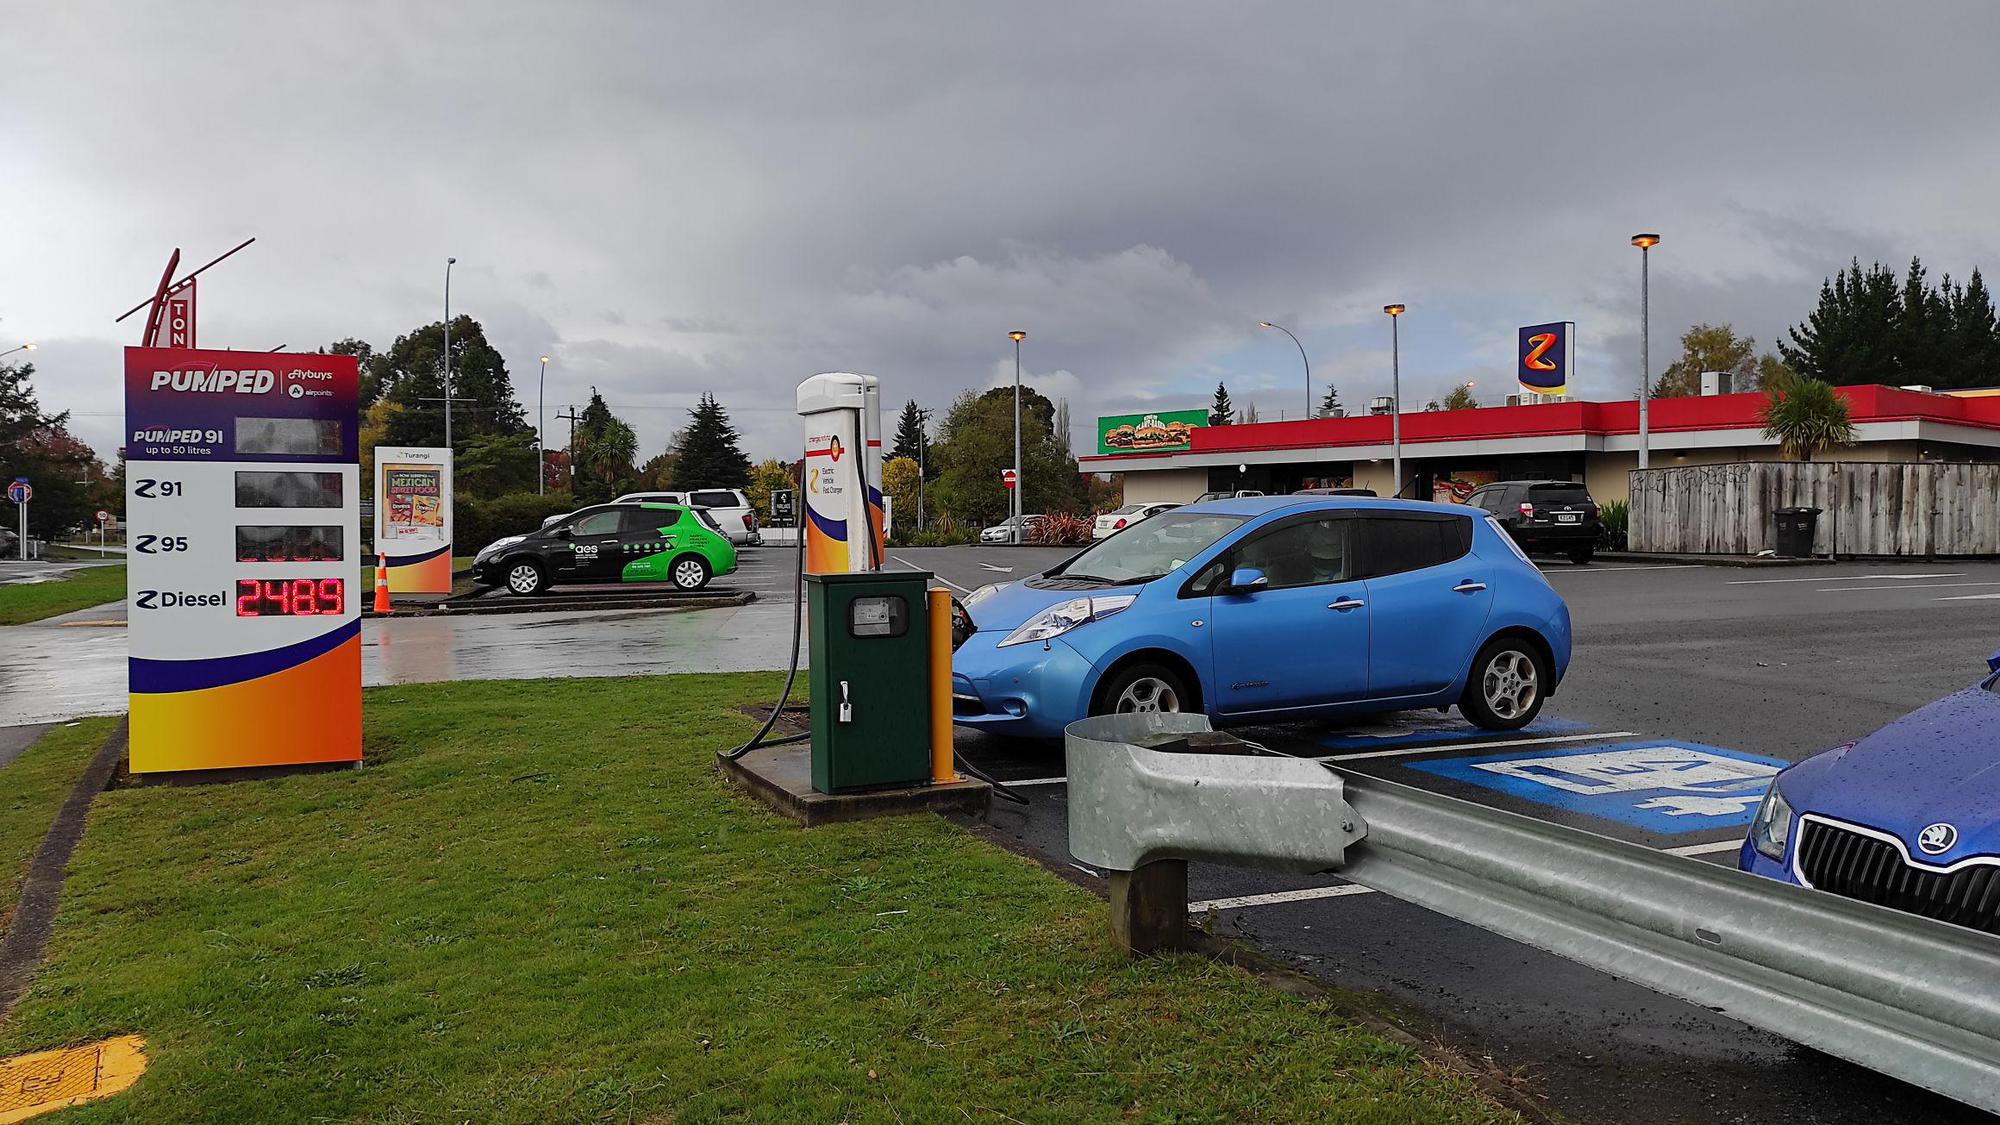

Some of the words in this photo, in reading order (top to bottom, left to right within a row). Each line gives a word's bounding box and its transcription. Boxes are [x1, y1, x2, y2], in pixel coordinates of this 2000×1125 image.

[1524, 332, 1558, 372] Z
[150, 366, 275, 395] PUMPED
[287, 368, 333, 381] flybuys
[305, 389, 333, 397] airpoints
[133, 428, 203, 444] PUMPED
[205, 429, 223, 444] 91
[145, 447, 158, 456] up
[160, 446, 171, 455] to
[172, 446, 185, 455] 50
[187, 446, 211, 455] litres
[404, 452, 430, 460] Turangi
[160, 481, 183, 497] 91
[391, 478, 436, 487] MEXICAN
[160, 536, 188, 553] 95
[575, 545, 599, 554] aes
[161, 590, 227, 607] Diesel
